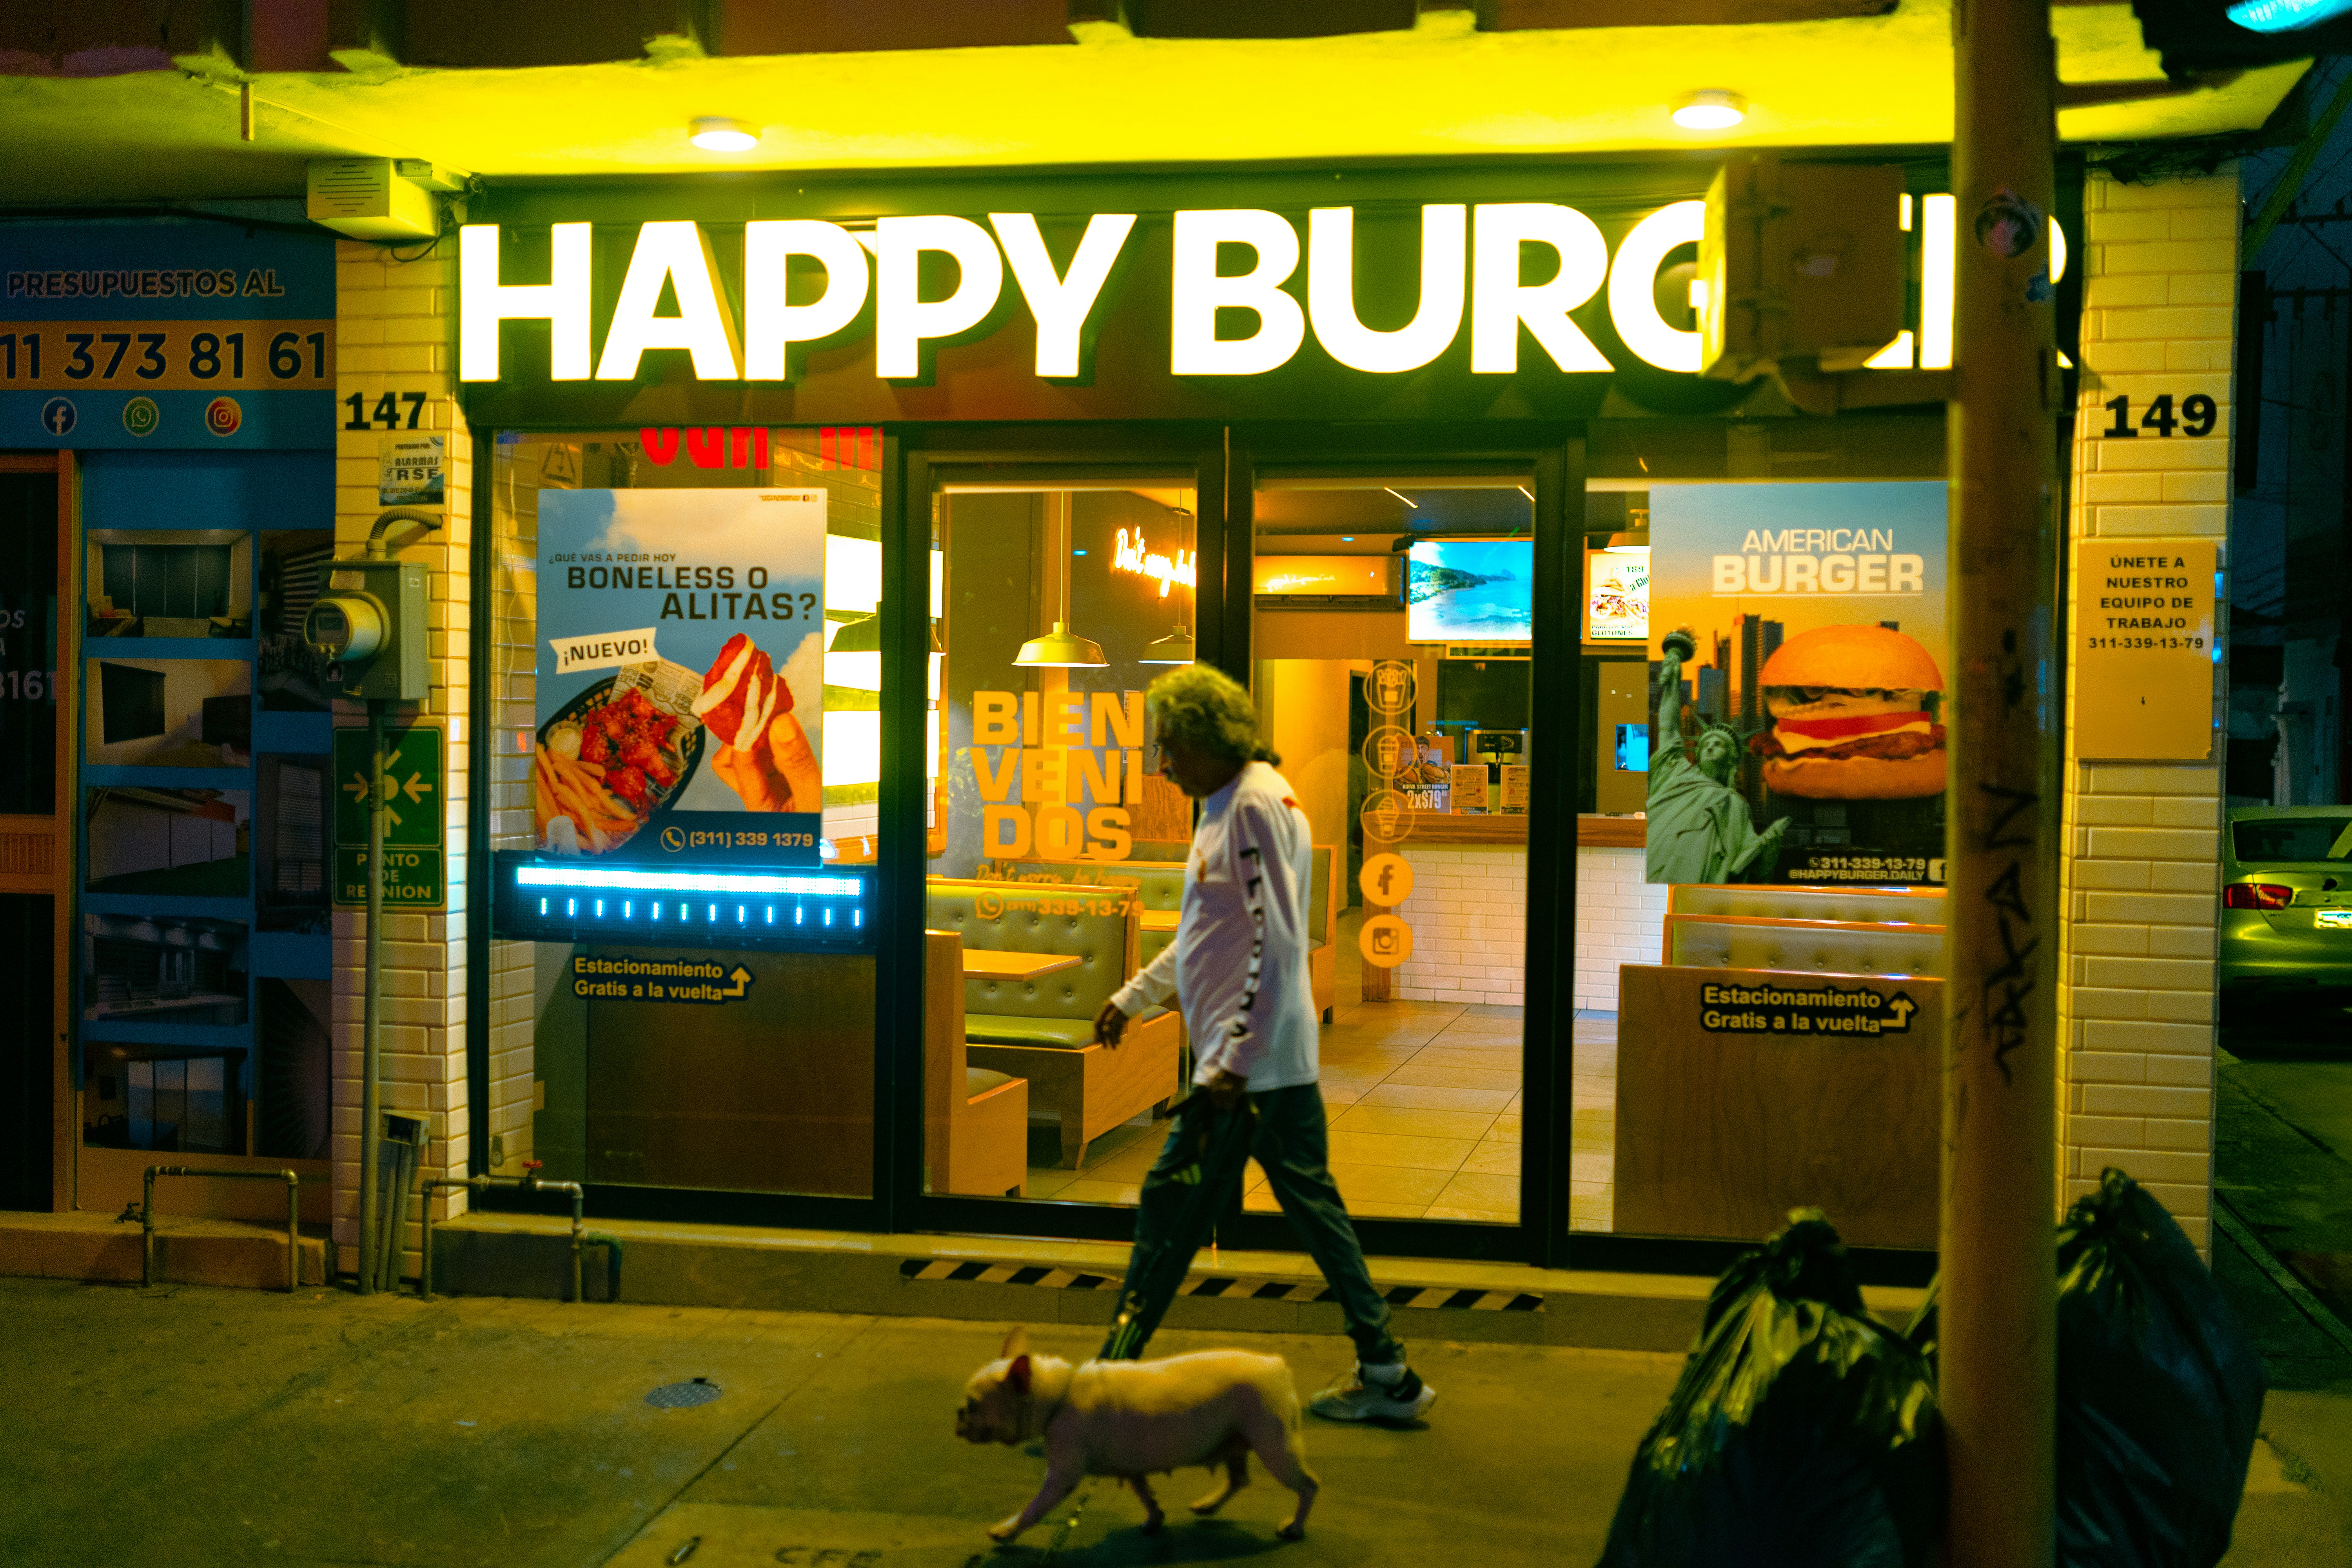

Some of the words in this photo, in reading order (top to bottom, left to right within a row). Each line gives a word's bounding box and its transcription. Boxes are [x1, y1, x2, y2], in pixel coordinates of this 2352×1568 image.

[7, 270, 236, 298] PRESUPUESTOS
[242, 269, 284, 296] AL
[459, 212, 1138, 381] HAPPY
[1171, 193, 2073, 376] BURG
[64, 333, 166, 379] 373
[189, 332, 243, 379] 81
[269, 332, 324, 379] 61
[345, 392, 426, 430] 147
[2104, 394, 2217, 438] 149
[395, 457, 438, 466] ALARMAS
[397, 468, 438, 481] RSE
[1742, 529, 1892, 552] AMERICAN
[617, 554, 650, 562] PEDIR
[2111, 555, 2168, 568] ÚNETE
[2174, 557, 2185, 568] A
[568, 566, 735, 589] BONELESS
[748, 566, 768, 589] O
[1713, 554, 1924, 592] BURGER
[2107, 577, 2189, 588] NUESTRO
[660, 592, 817, 620] ALITAS?
[2101, 597, 2165, 609] EQUIPO
[2172, 597, 2193, 608] DE
[2106, 617, 2186, 629] TRABAJO
[564, 638, 648, 666] ¡NUEVO!
[2089, 638, 2203, 649] 311-339-13-79
[973, 691, 1144, 747] BIEN
[970, 748, 1143, 804] VENI
[690, 831, 731, 848] (311)
[735, 831, 768, 847] 339
[772, 831, 813, 847] 1379
[984, 805, 1132, 861] DOS
[357, 853, 419, 867] PNTO
[1820, 857, 1926, 869] 311-339-13-79
[1789, 869, 1924, 880] @HAPPYBURGER.DAILY
[347, 882, 430, 898] RENIÓN
[1038, 899, 1145, 918] 339-13-79
[574, 957, 722, 978] Estacionamiento
[575, 980, 626, 996] Gratis
[632, 984, 642, 997] a
[648, 982, 663, 998] la
[669, 983, 722, 1001] vuelta
[1705, 986, 1881, 1008] Estacionamiento
[1704, 1011, 1766, 1029] Gratis
[1773, 1016, 1785, 1029] a
[1792, 1012, 1809, 1030] la
[1815, 1014, 1880, 1033] vuelta
